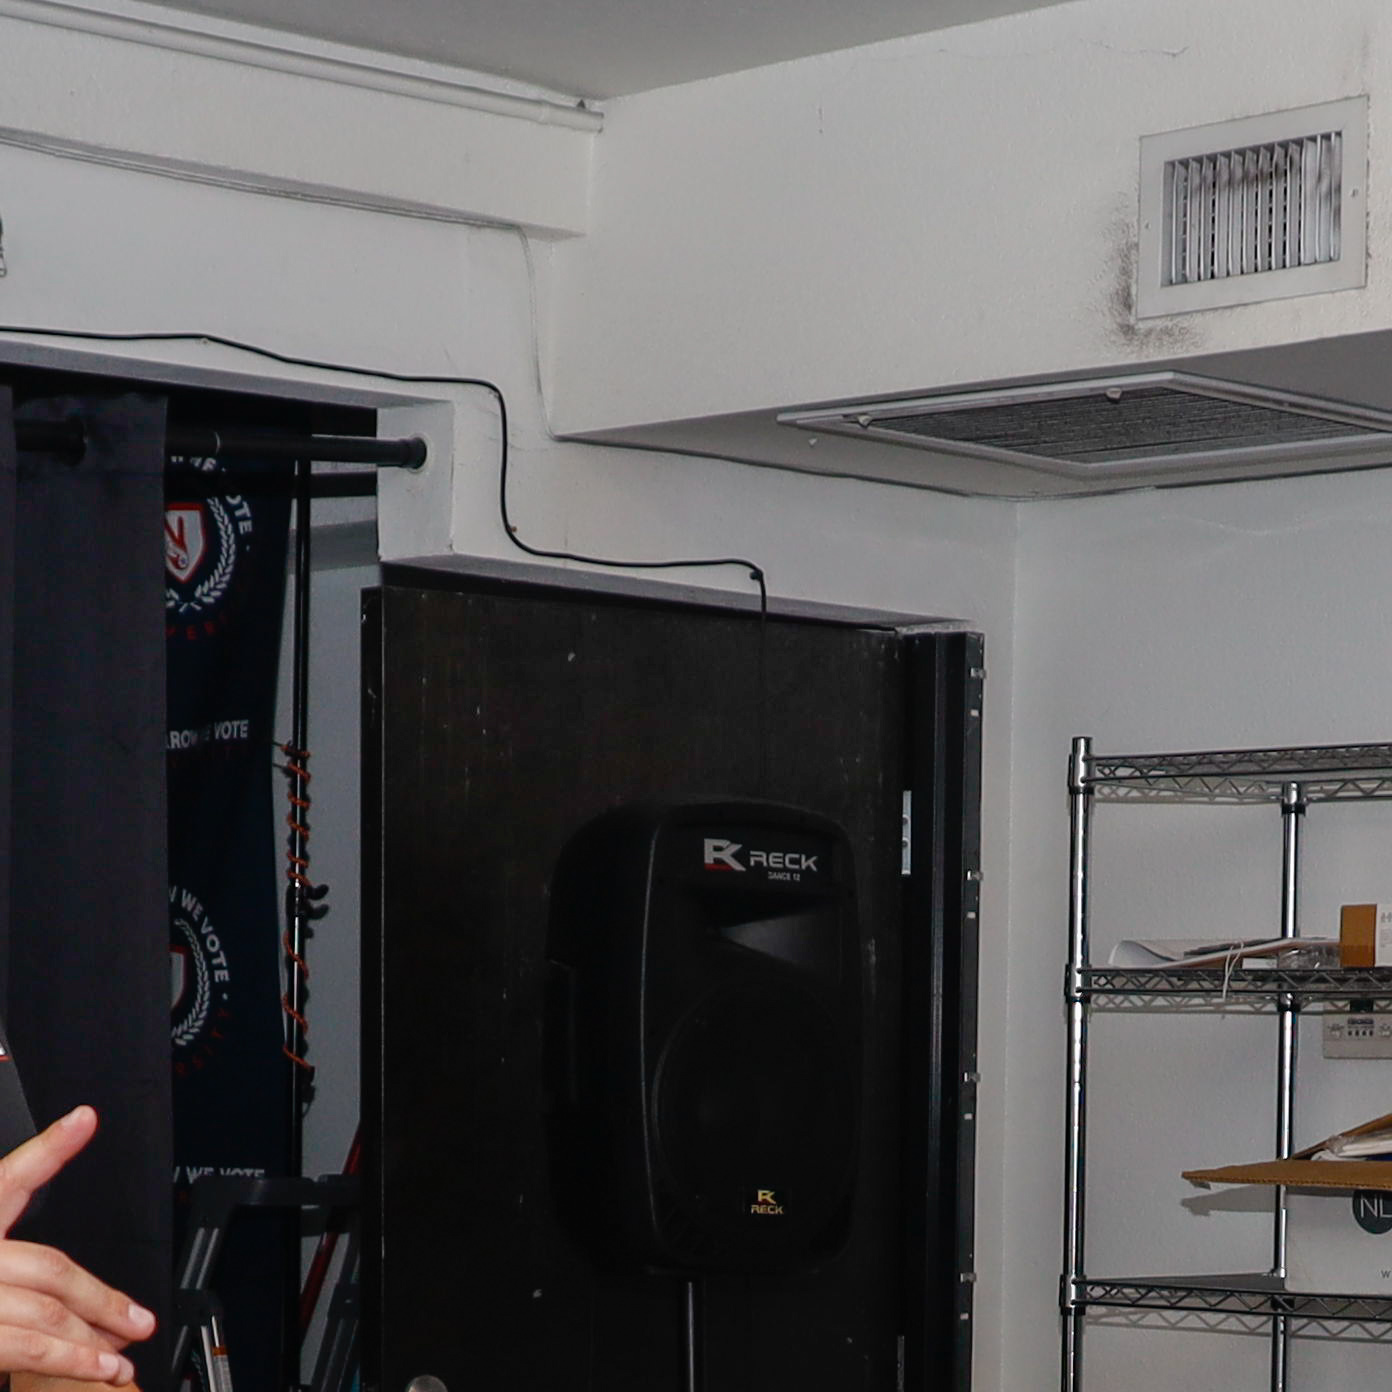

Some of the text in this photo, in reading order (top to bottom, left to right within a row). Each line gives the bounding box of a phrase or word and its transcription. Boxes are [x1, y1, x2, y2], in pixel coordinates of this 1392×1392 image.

[214, 719, 249, 740] VOTE
[750, 850, 818, 871] RECK
[182, 888, 205, 921] WE
[200, 916, 230, 983] VOTE
[751, 1204, 784, 1215] RECK
[1360, 1193, 1392, 1219] NL
